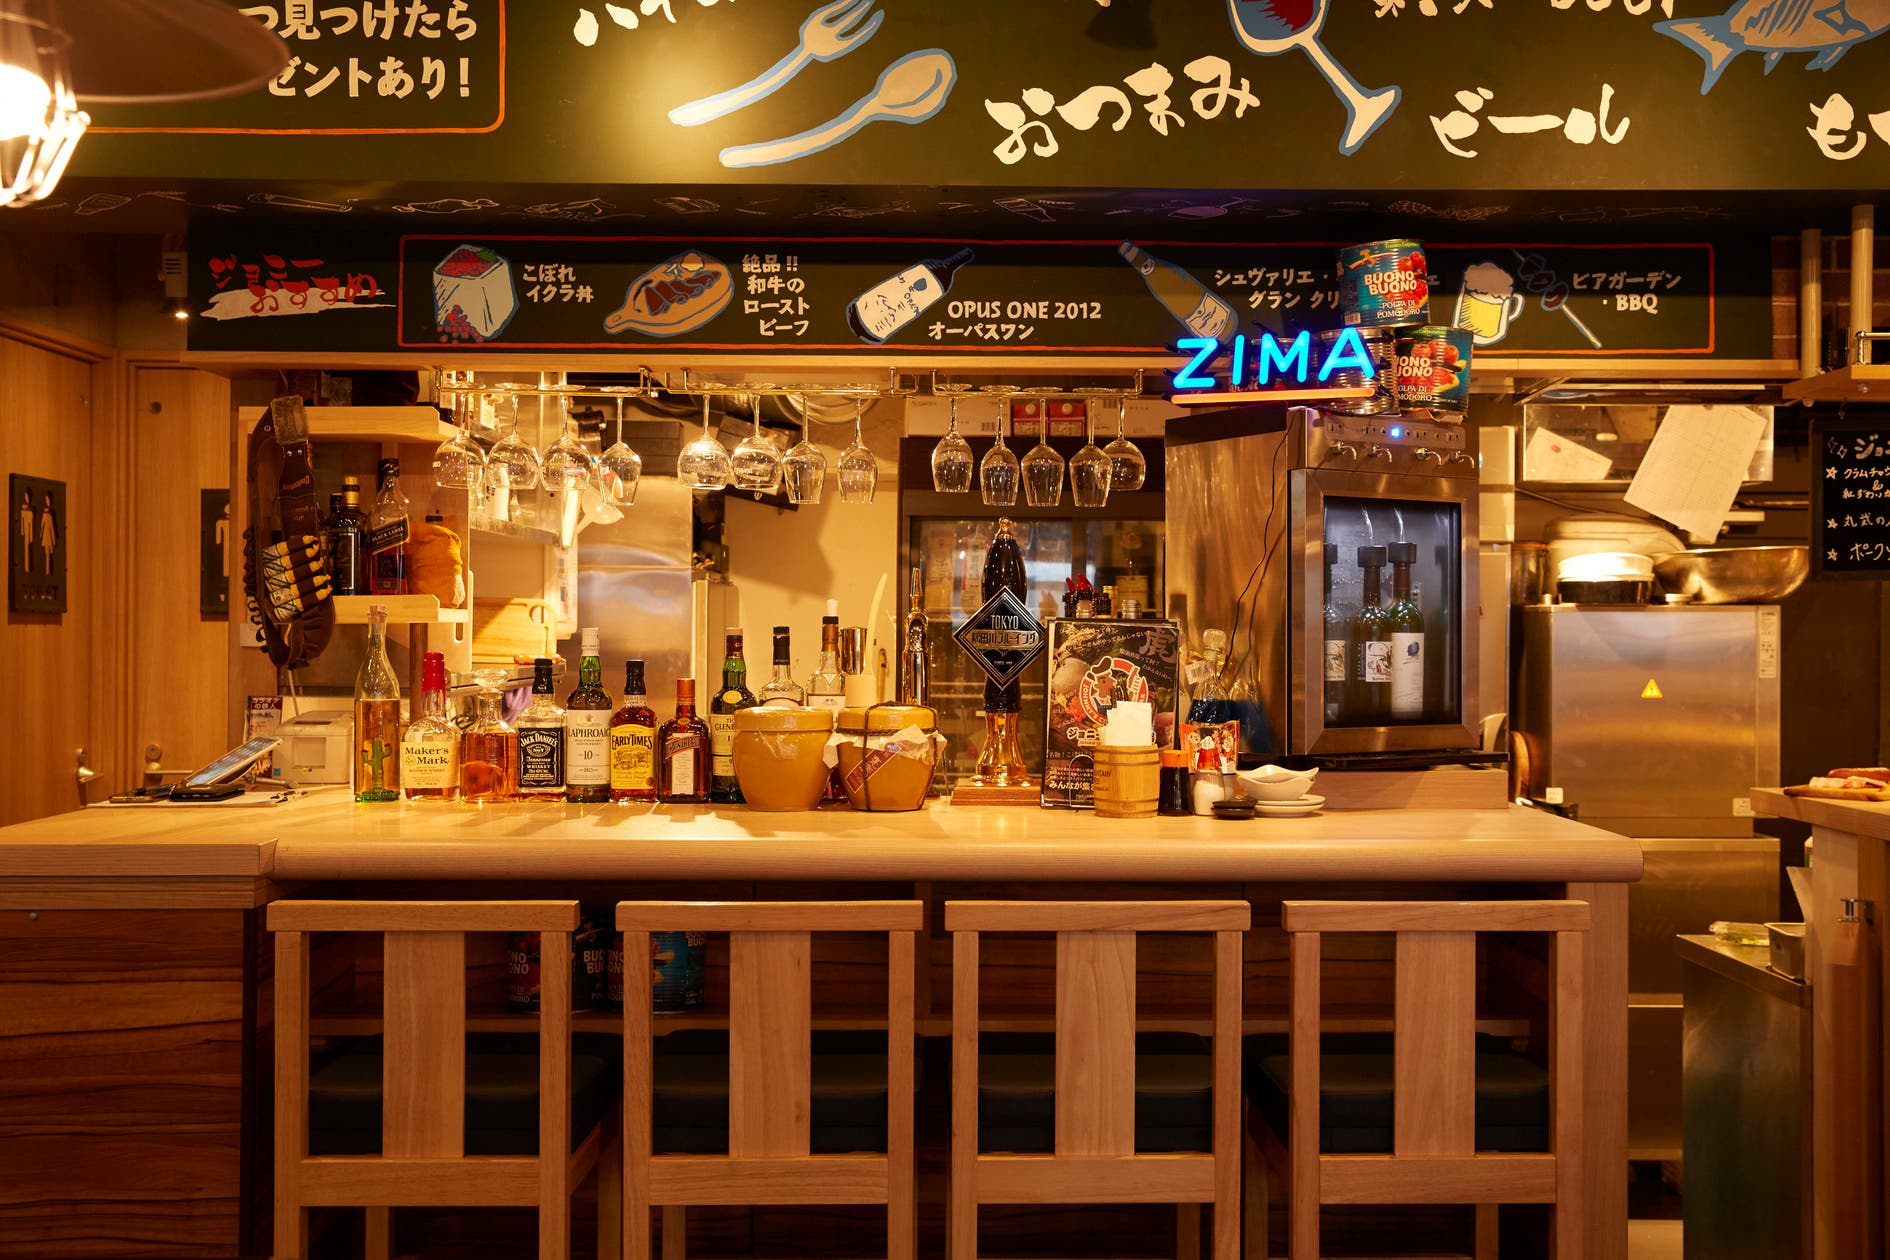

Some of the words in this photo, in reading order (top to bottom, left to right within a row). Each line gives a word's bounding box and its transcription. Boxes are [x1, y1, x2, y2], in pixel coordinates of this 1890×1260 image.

[985, 55, 1260, 164] おつまみ
[522, 263, 576, 283] こぼれ
[1364, 271, 1415, 286] BUONO
[1573, 271, 1681, 290] ビアガーデン
[249, 272, 378, 314] おすすめ
[526, 284, 594, 303] イクラ丼
[747, 276, 805, 295] 和牛の
[1369, 279, 1418, 296] BUONO
[743, 298, 810, 316] ロースト
[1249, 290, 1301, 309] グラン
[1382, 301, 1406, 309] POLPA
[948, 300, 1001, 319] OPUS
[1007, 301, 1049, 319] ONE
[1054, 301, 1102, 320] 2012
[1376, 308, 1420, 319] POMODORO
[759, 318, 809, 337] ビーフ
[928, 321, 1034, 340] オーパスワン
[1172, 326, 1376, 389] ZIMA
[990, 614, 1019, 629] TOKYO
[405, 746, 449, 755] Maker's
[612, 734, 632, 750] EARLY
[629, 733, 653, 750] TIMES
[417, 756, 449, 765] Mark
[583, 750, 593, 760] 10
